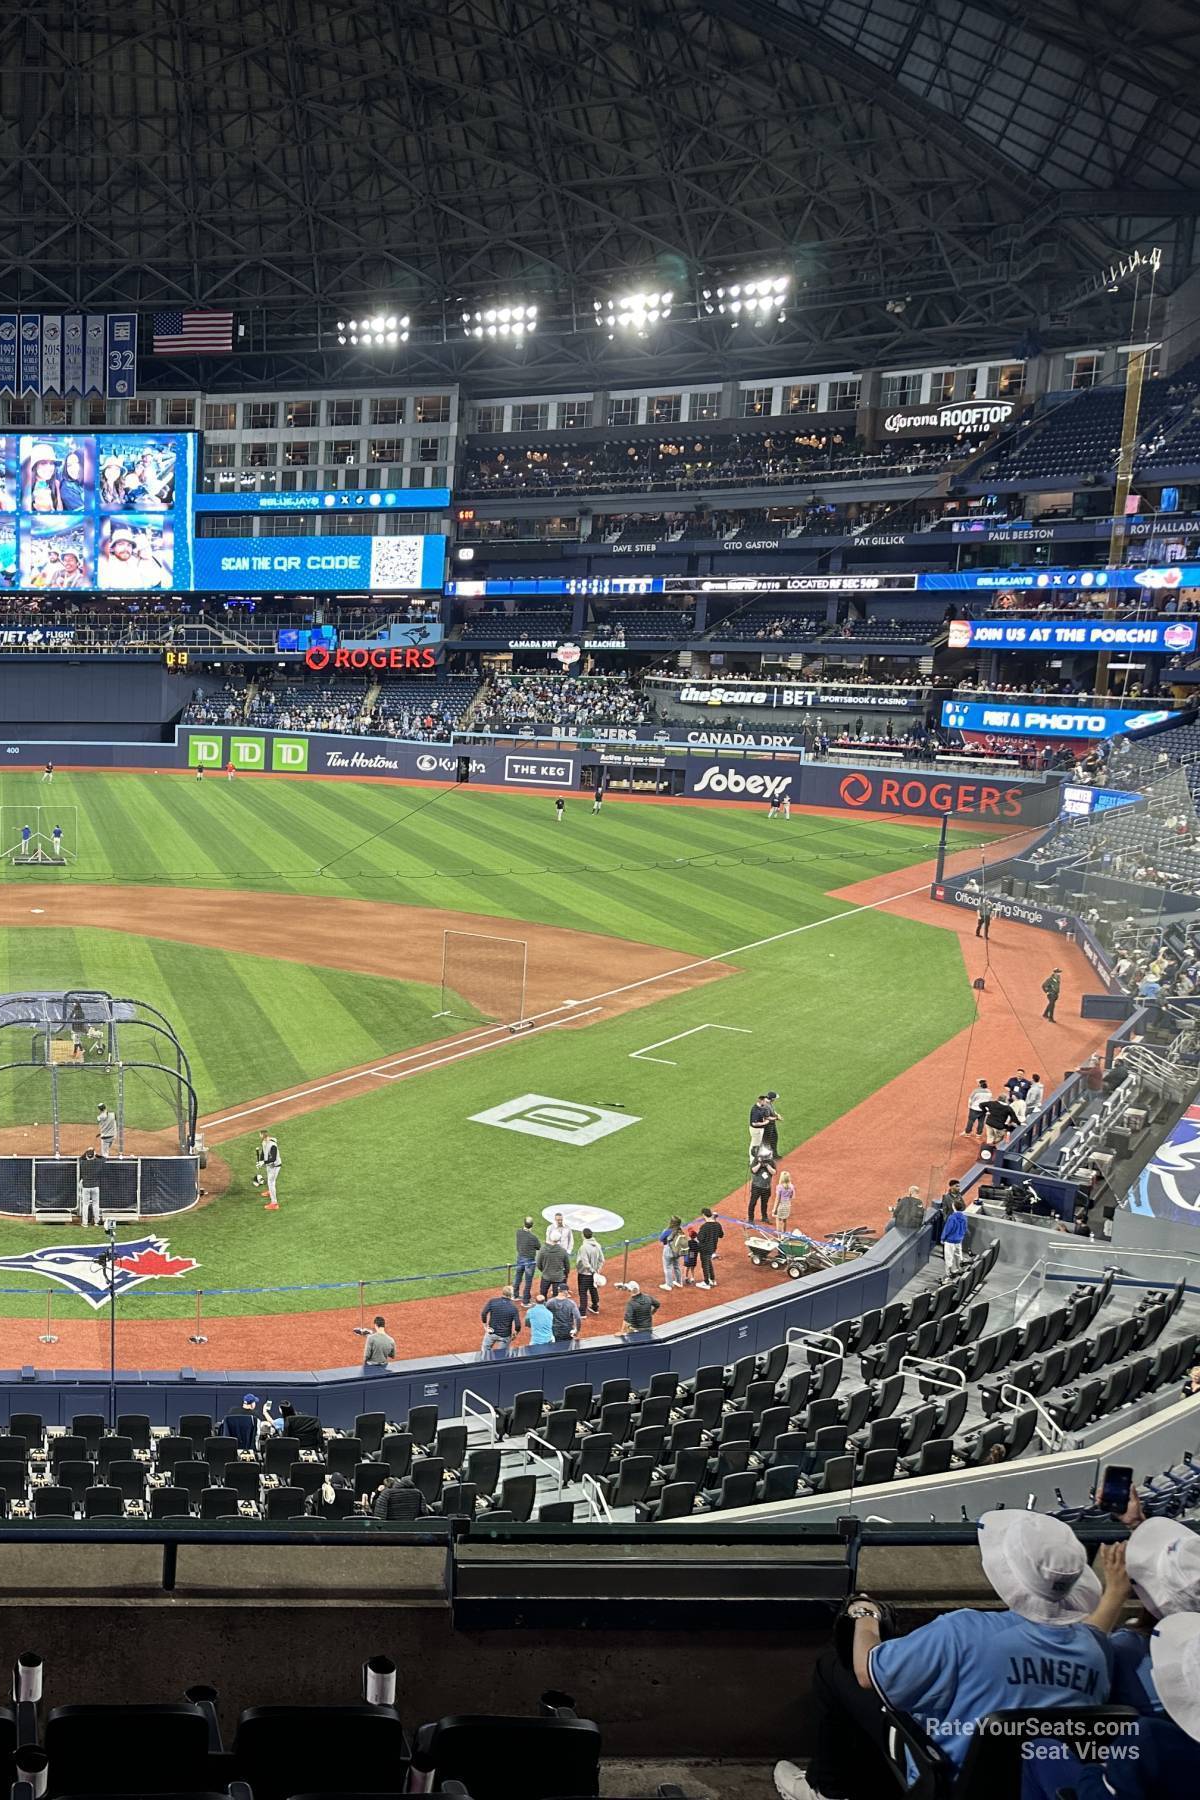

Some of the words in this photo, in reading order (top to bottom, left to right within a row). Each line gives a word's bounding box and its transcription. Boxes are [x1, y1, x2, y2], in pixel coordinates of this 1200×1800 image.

[0, 344, 15, 355] 1992
[23, 344, 38, 355] 1993
[44, 344, 60, 356] 2015
[109, 350, 135, 371] 32
[885, 413, 938, 432] Corona
[940, 406, 1012, 427] ROOFTOP
[959, 424, 990, 433] PATIO
[988, 531, 1010, 541] PAUL
[1012, 529, 1054, 540] BEESTON
[1130, 525, 1150, 534] ROY
[1152, 522, 1200, 533] HALLADA
[612, 544, 633, 553] DAVE
[635, 543, 656, 552] STIEB
[724, 541, 743, 550] CITO
[745, 540, 779, 550] GASTON
[854, 537, 869, 546] PAT
[871, 536, 905, 546] GILLICK
[221, 558, 250, 571] SCAN
[252, 557, 271, 570] THE
[273, 556, 301, 571] QR
[306, 555, 362, 570] CODE
[787, 579, 828, 589] LOCATED
[974, 627, 1002, 641] JOIN
[1006, 628, 1025, 641] US
[1029, 628, 1052, 642] AT
[1055, 628, 1085, 642] THE
[1090, 628, 1157, 643] PORCH!
[509, 640, 540, 648] CANADA
[542, 640, 558, 648] DRY
[584, 640, 625, 648] BLEACHERS
[334, 648, 435, 669] ROGERS
[680, 687, 767, 703] theScore
[783, 690, 816, 705] BET
[820, 695, 869, 705] SPORTSBOOK
[878, 697, 907, 705] CASINO
[1010, 713, 1020, 727] A
[1025, 713, 1106, 732] PHOTO
[552, 726, 637, 741] BLEHERS
[687, 731, 756, 746] CANADA
[761, 734, 795, 748] DRY
[996, 735, 1037, 745] ROGERS
[193, 741, 219, 761] TD
[235, 742, 261, 763] TD
[277, 743, 305, 764] TD
[326, 752, 350, 767] Tim
[350, 752, 399, 770] Hortons
[513, 764, 537, 775] THE
[541, 766, 565, 777] KEG
[694, 766, 792, 798] Sobeys
[881, 779, 1022, 817] ROGERS
[955, 891, 982, 906] Official
[1012, 905, 1043, 924] Shingle
[1007, 1656, 1100, 1696] JANSEN
